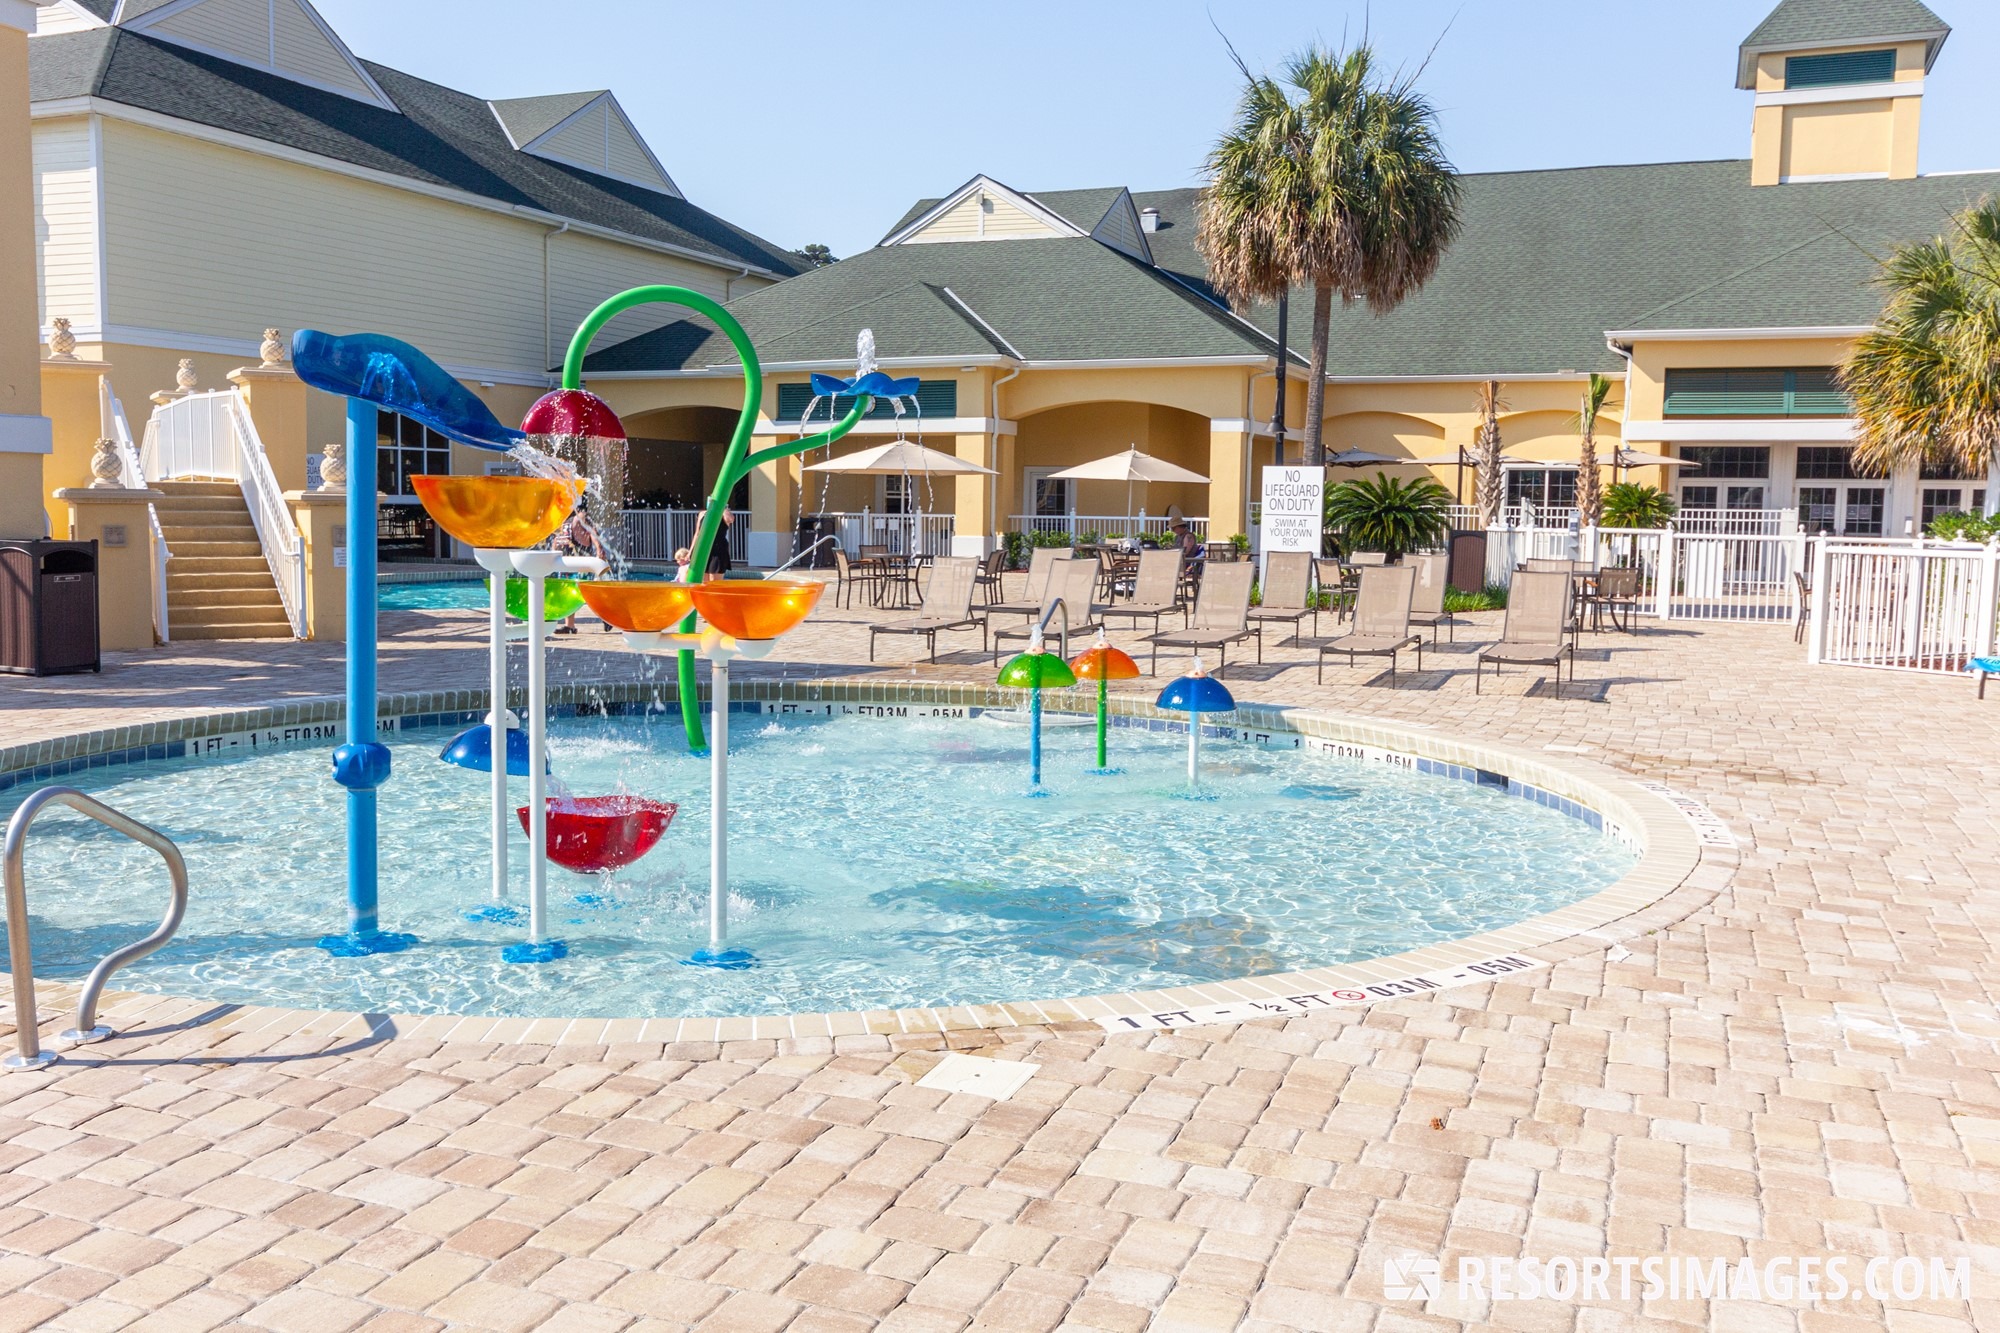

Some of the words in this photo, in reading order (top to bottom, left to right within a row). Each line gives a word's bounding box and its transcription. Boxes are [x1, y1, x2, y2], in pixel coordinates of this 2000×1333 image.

[1285, 470, 1300, 482] NO
[1265, 484, 1319, 497] LIFEGUARD
[1269, 498, 1284, 510] ON
[1287, 498, 1314, 511] DUTY
[1275, 518, 1296, 527] SWIM
[1298, 519, 1307, 527] AT
[1269, 528, 1290, 536] YOUR
[1292, 528, 1312, 537] OWN
[1282, 537, 1298, 546] RISK
[192, 741, 199, 754] 1
[207, 737, 223, 752] FT
[250, 733, 256, 745] 1
[1118, 1017, 1142, 1028] 1
[1152, 1010, 1196, 1026] FT
[1286, 994, 1330, 1008] FT
